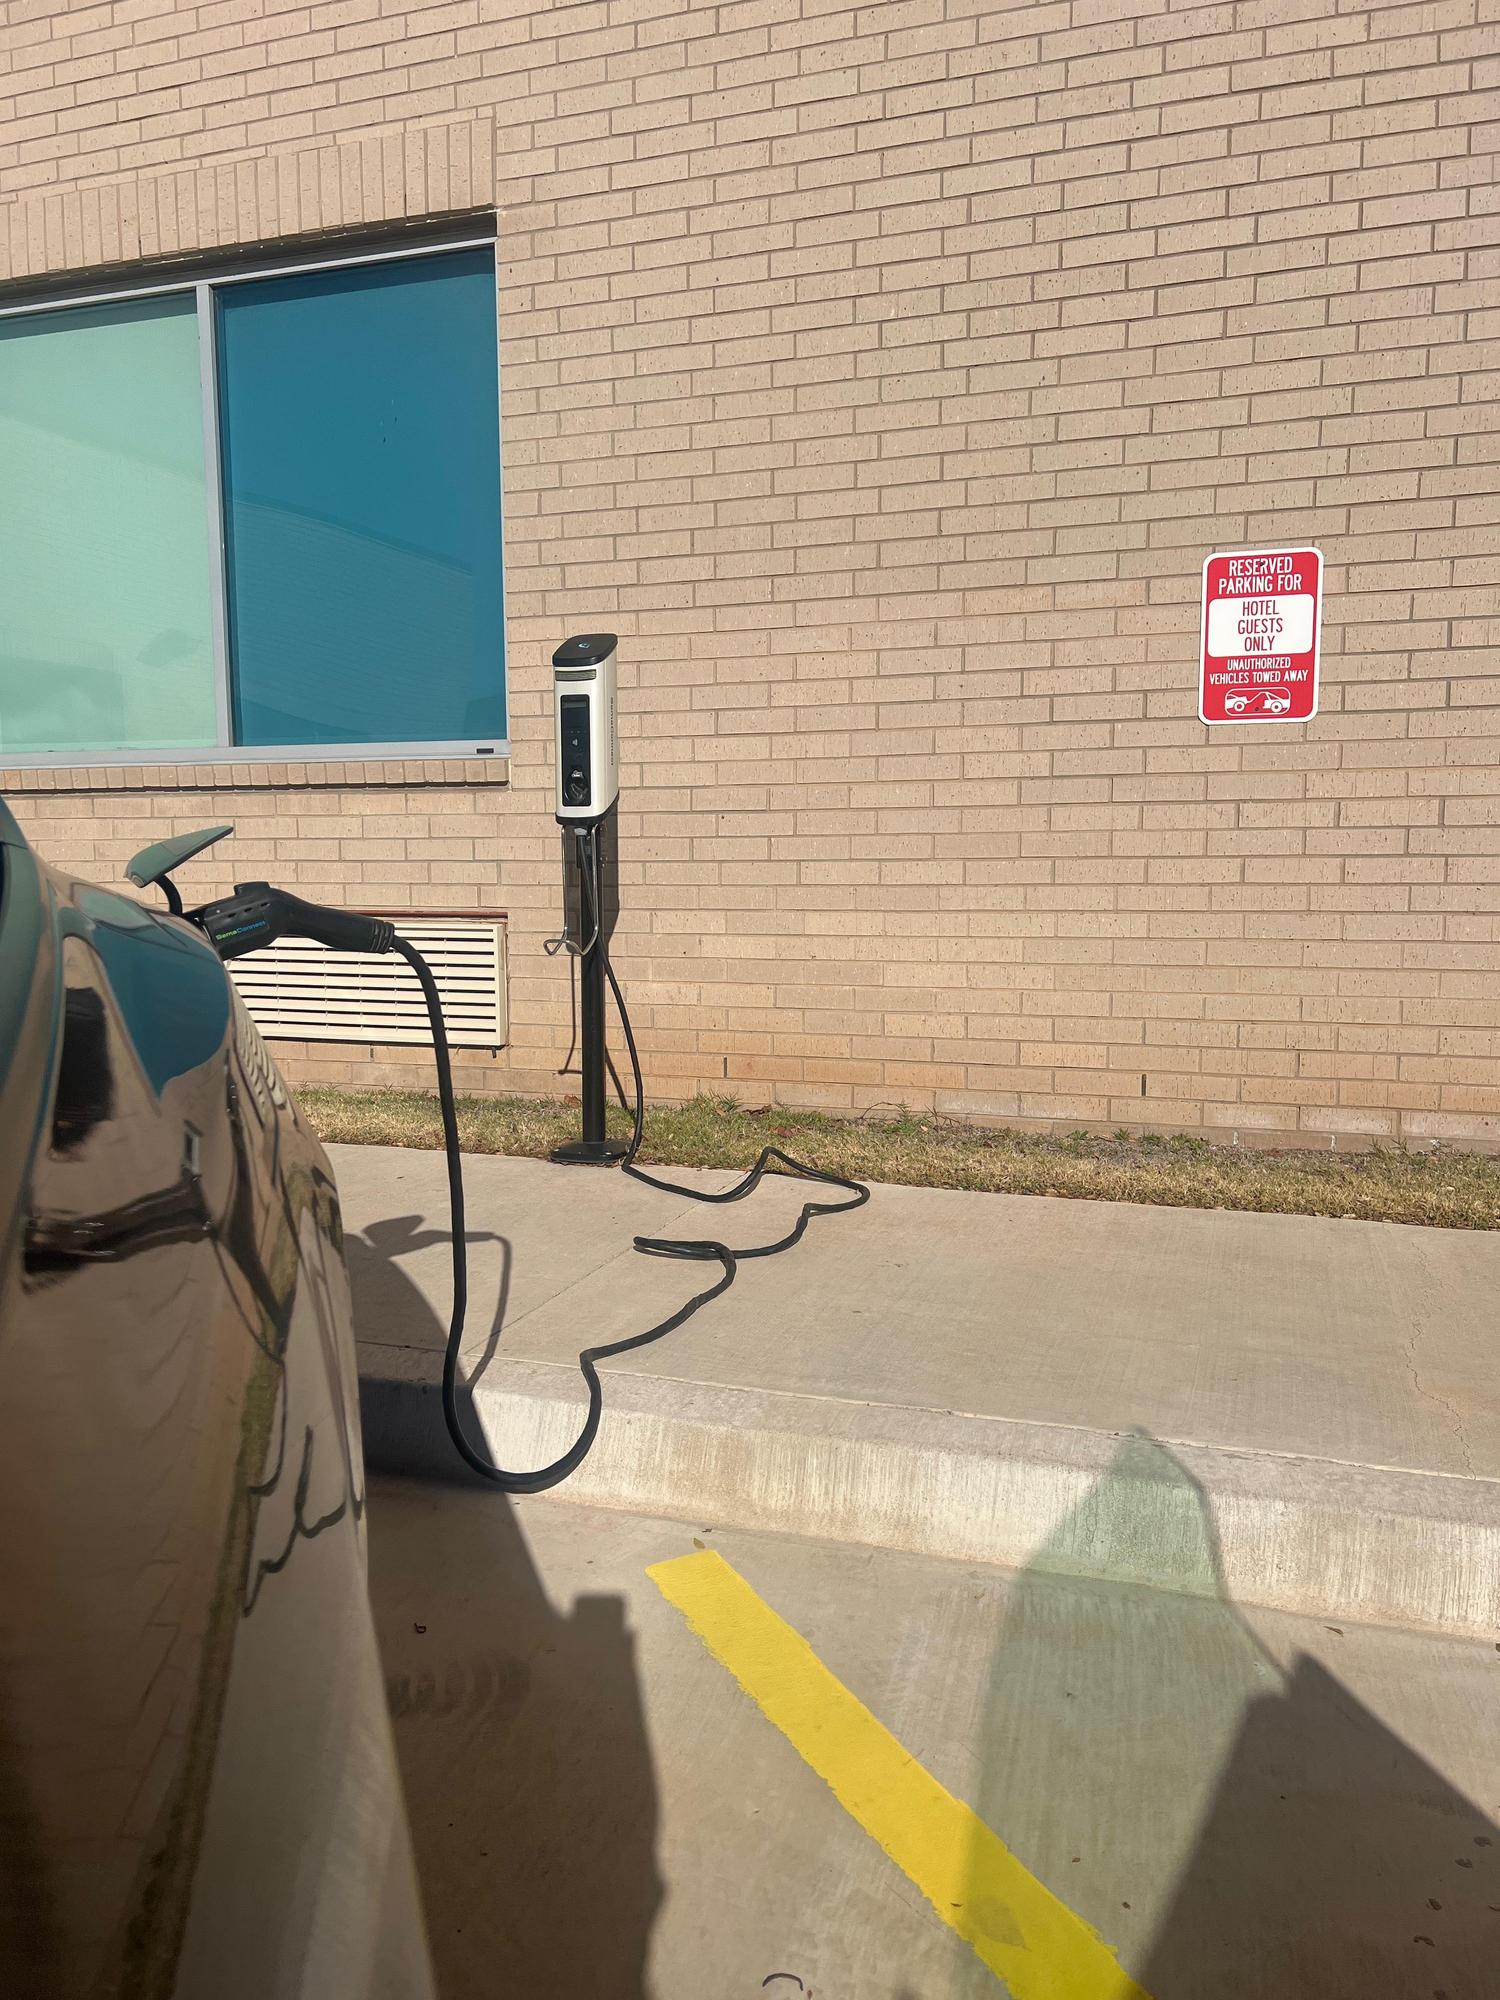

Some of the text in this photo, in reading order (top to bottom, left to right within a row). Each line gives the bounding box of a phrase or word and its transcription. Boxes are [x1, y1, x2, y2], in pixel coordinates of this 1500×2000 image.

[1228, 556, 1293, 577] RESERVED
[1218, 573, 1302, 595] PARKING FOR
[1242, 600, 1279, 616] HOTEL
[1237, 617, 1283, 635] GUESTS
[1244, 635, 1275, 652] ONLY
[1227, 656, 1291, 671] UNAUTHORIZED
[1209, 669, 1309, 685] VEHICLES TOWED AWAY
